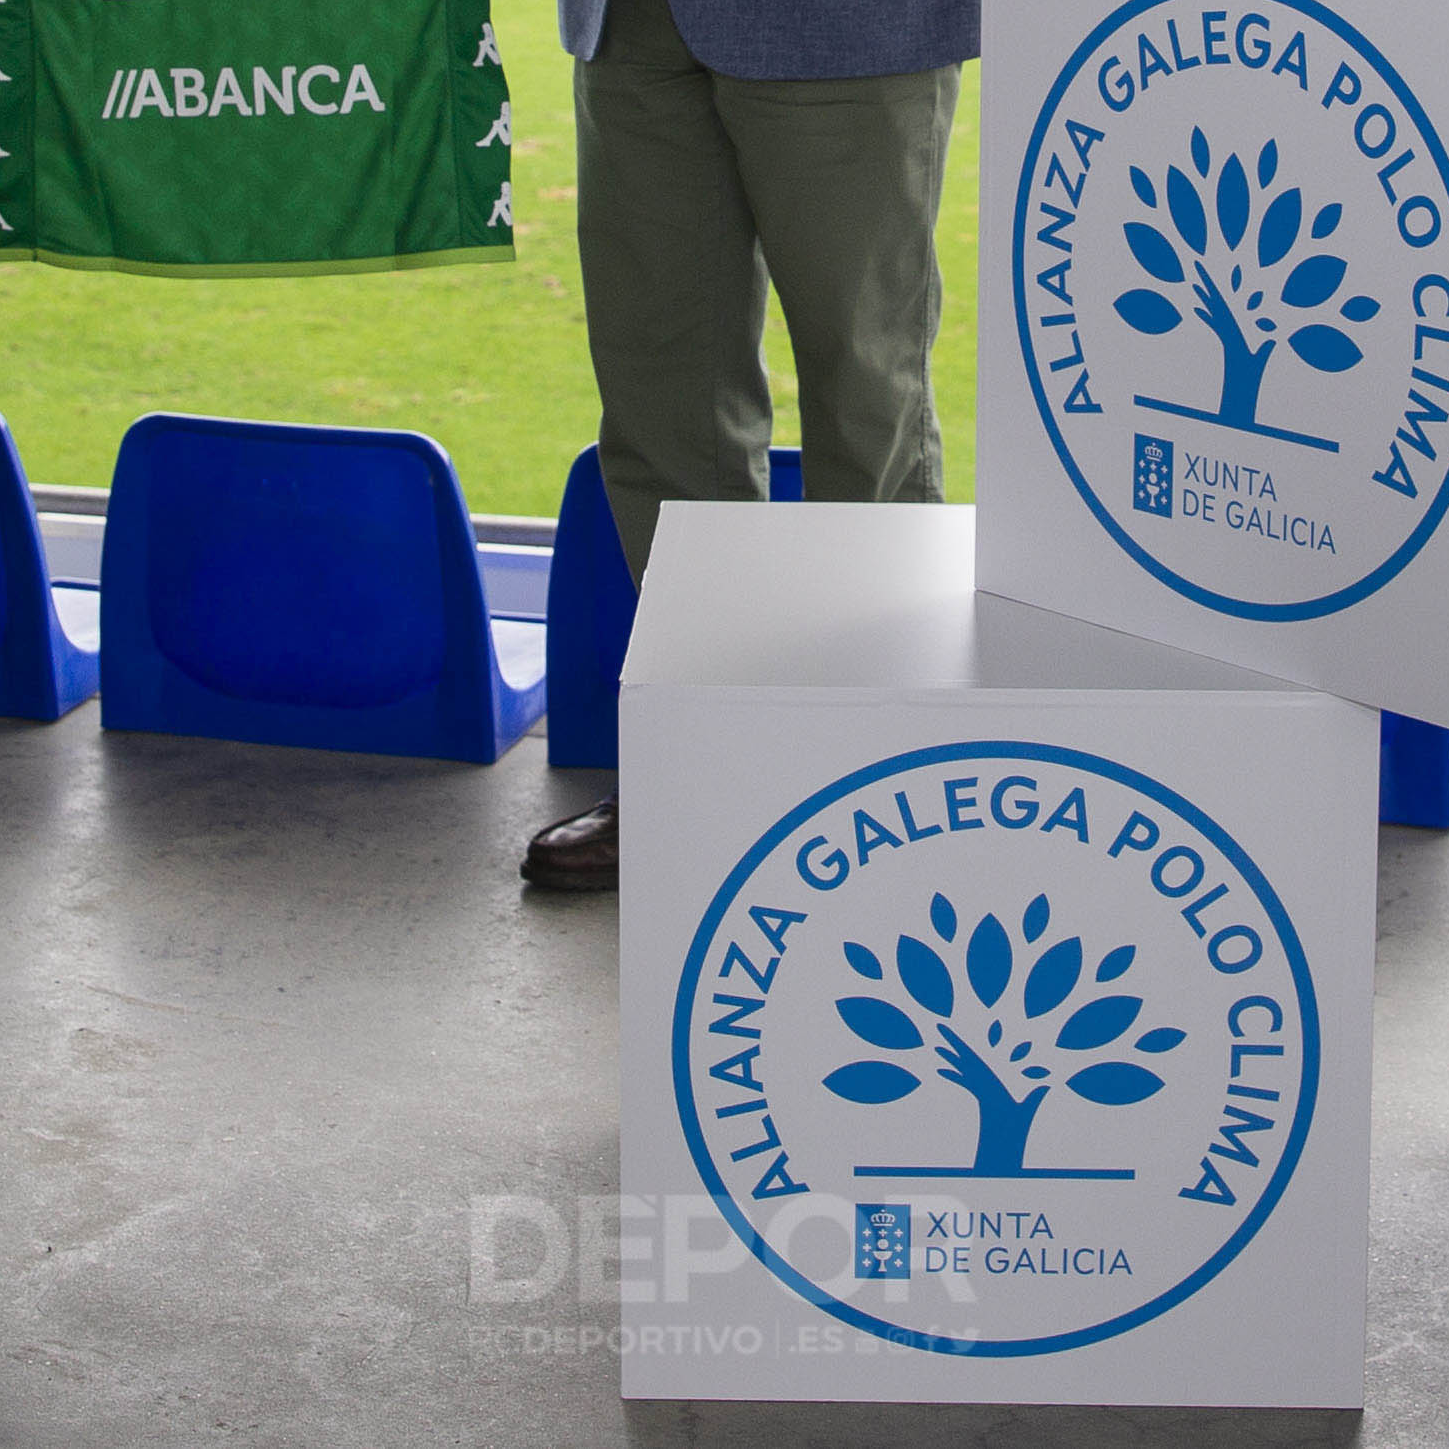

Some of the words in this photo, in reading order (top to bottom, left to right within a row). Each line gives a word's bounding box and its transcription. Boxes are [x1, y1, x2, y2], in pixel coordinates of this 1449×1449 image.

[1037, 119, 1105, 414] ALIANZA
[1098, 10, 1309, 112] GALEGA
[1321, 61, 1441, 248] POLO
[1182, 488, 1215, 523] DE
[1226, 501, 1337, 555] GALICIA
[1184, 453, 1278, 502] XUNTA
[796, 775, 1090, 891] GALEGA
[1107, 809, 1264, 975] POLO
[708, 904, 811, 1202] ALIANZA
[1177, 994, 1285, 1207] CLIMA
[925, 1246, 970, 1275] DE
[984, 1247, 1133, 1276] GALICIA
[926, 1211, 1055, 1239] XUNTA
